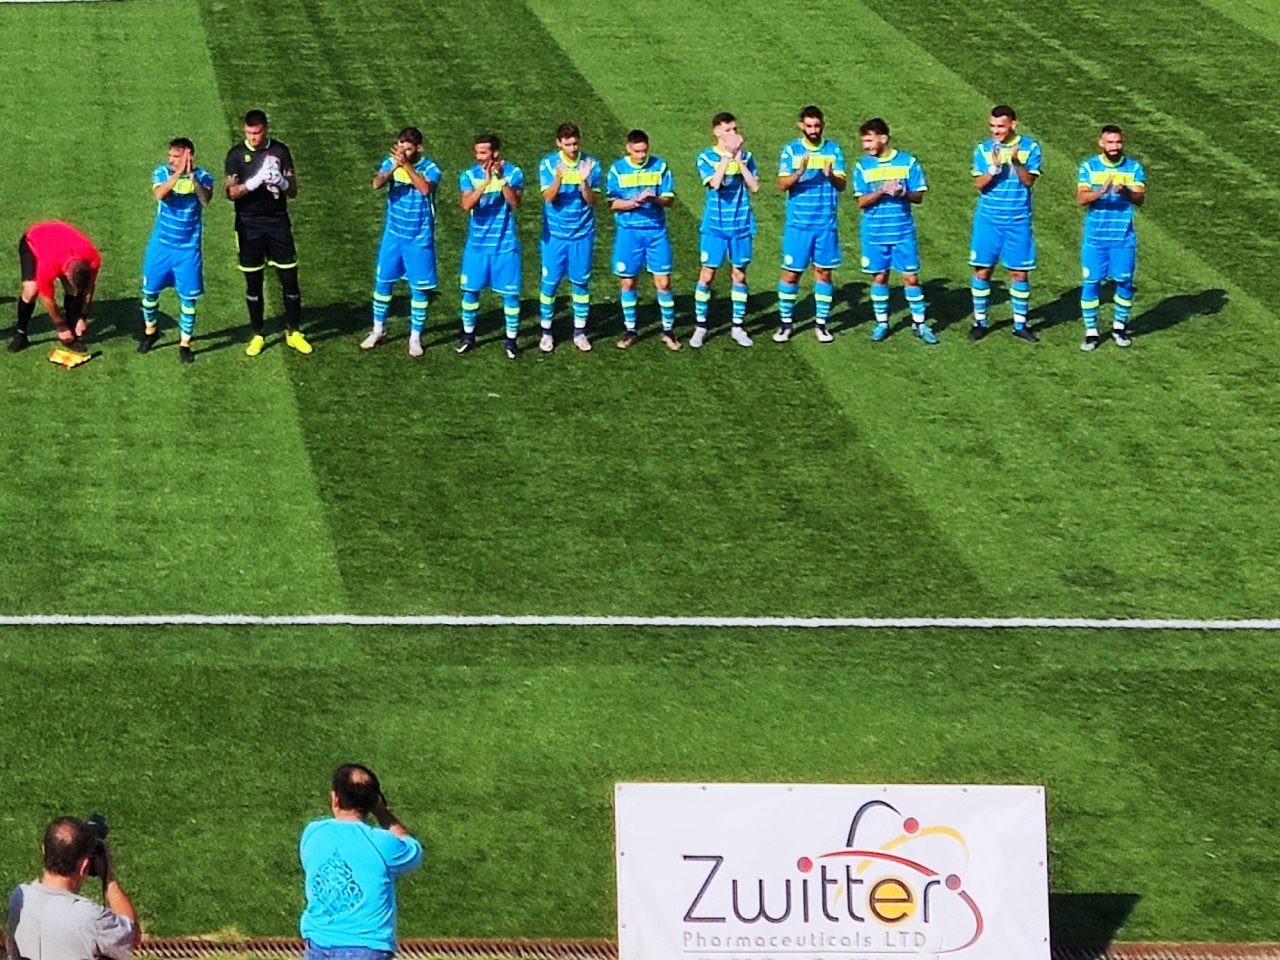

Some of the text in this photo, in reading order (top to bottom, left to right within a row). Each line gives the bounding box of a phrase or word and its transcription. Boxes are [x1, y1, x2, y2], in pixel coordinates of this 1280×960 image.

[682, 854, 941, 924] Zwitter
[682, 929, 927, 948] Pharmaceuticals LTD
